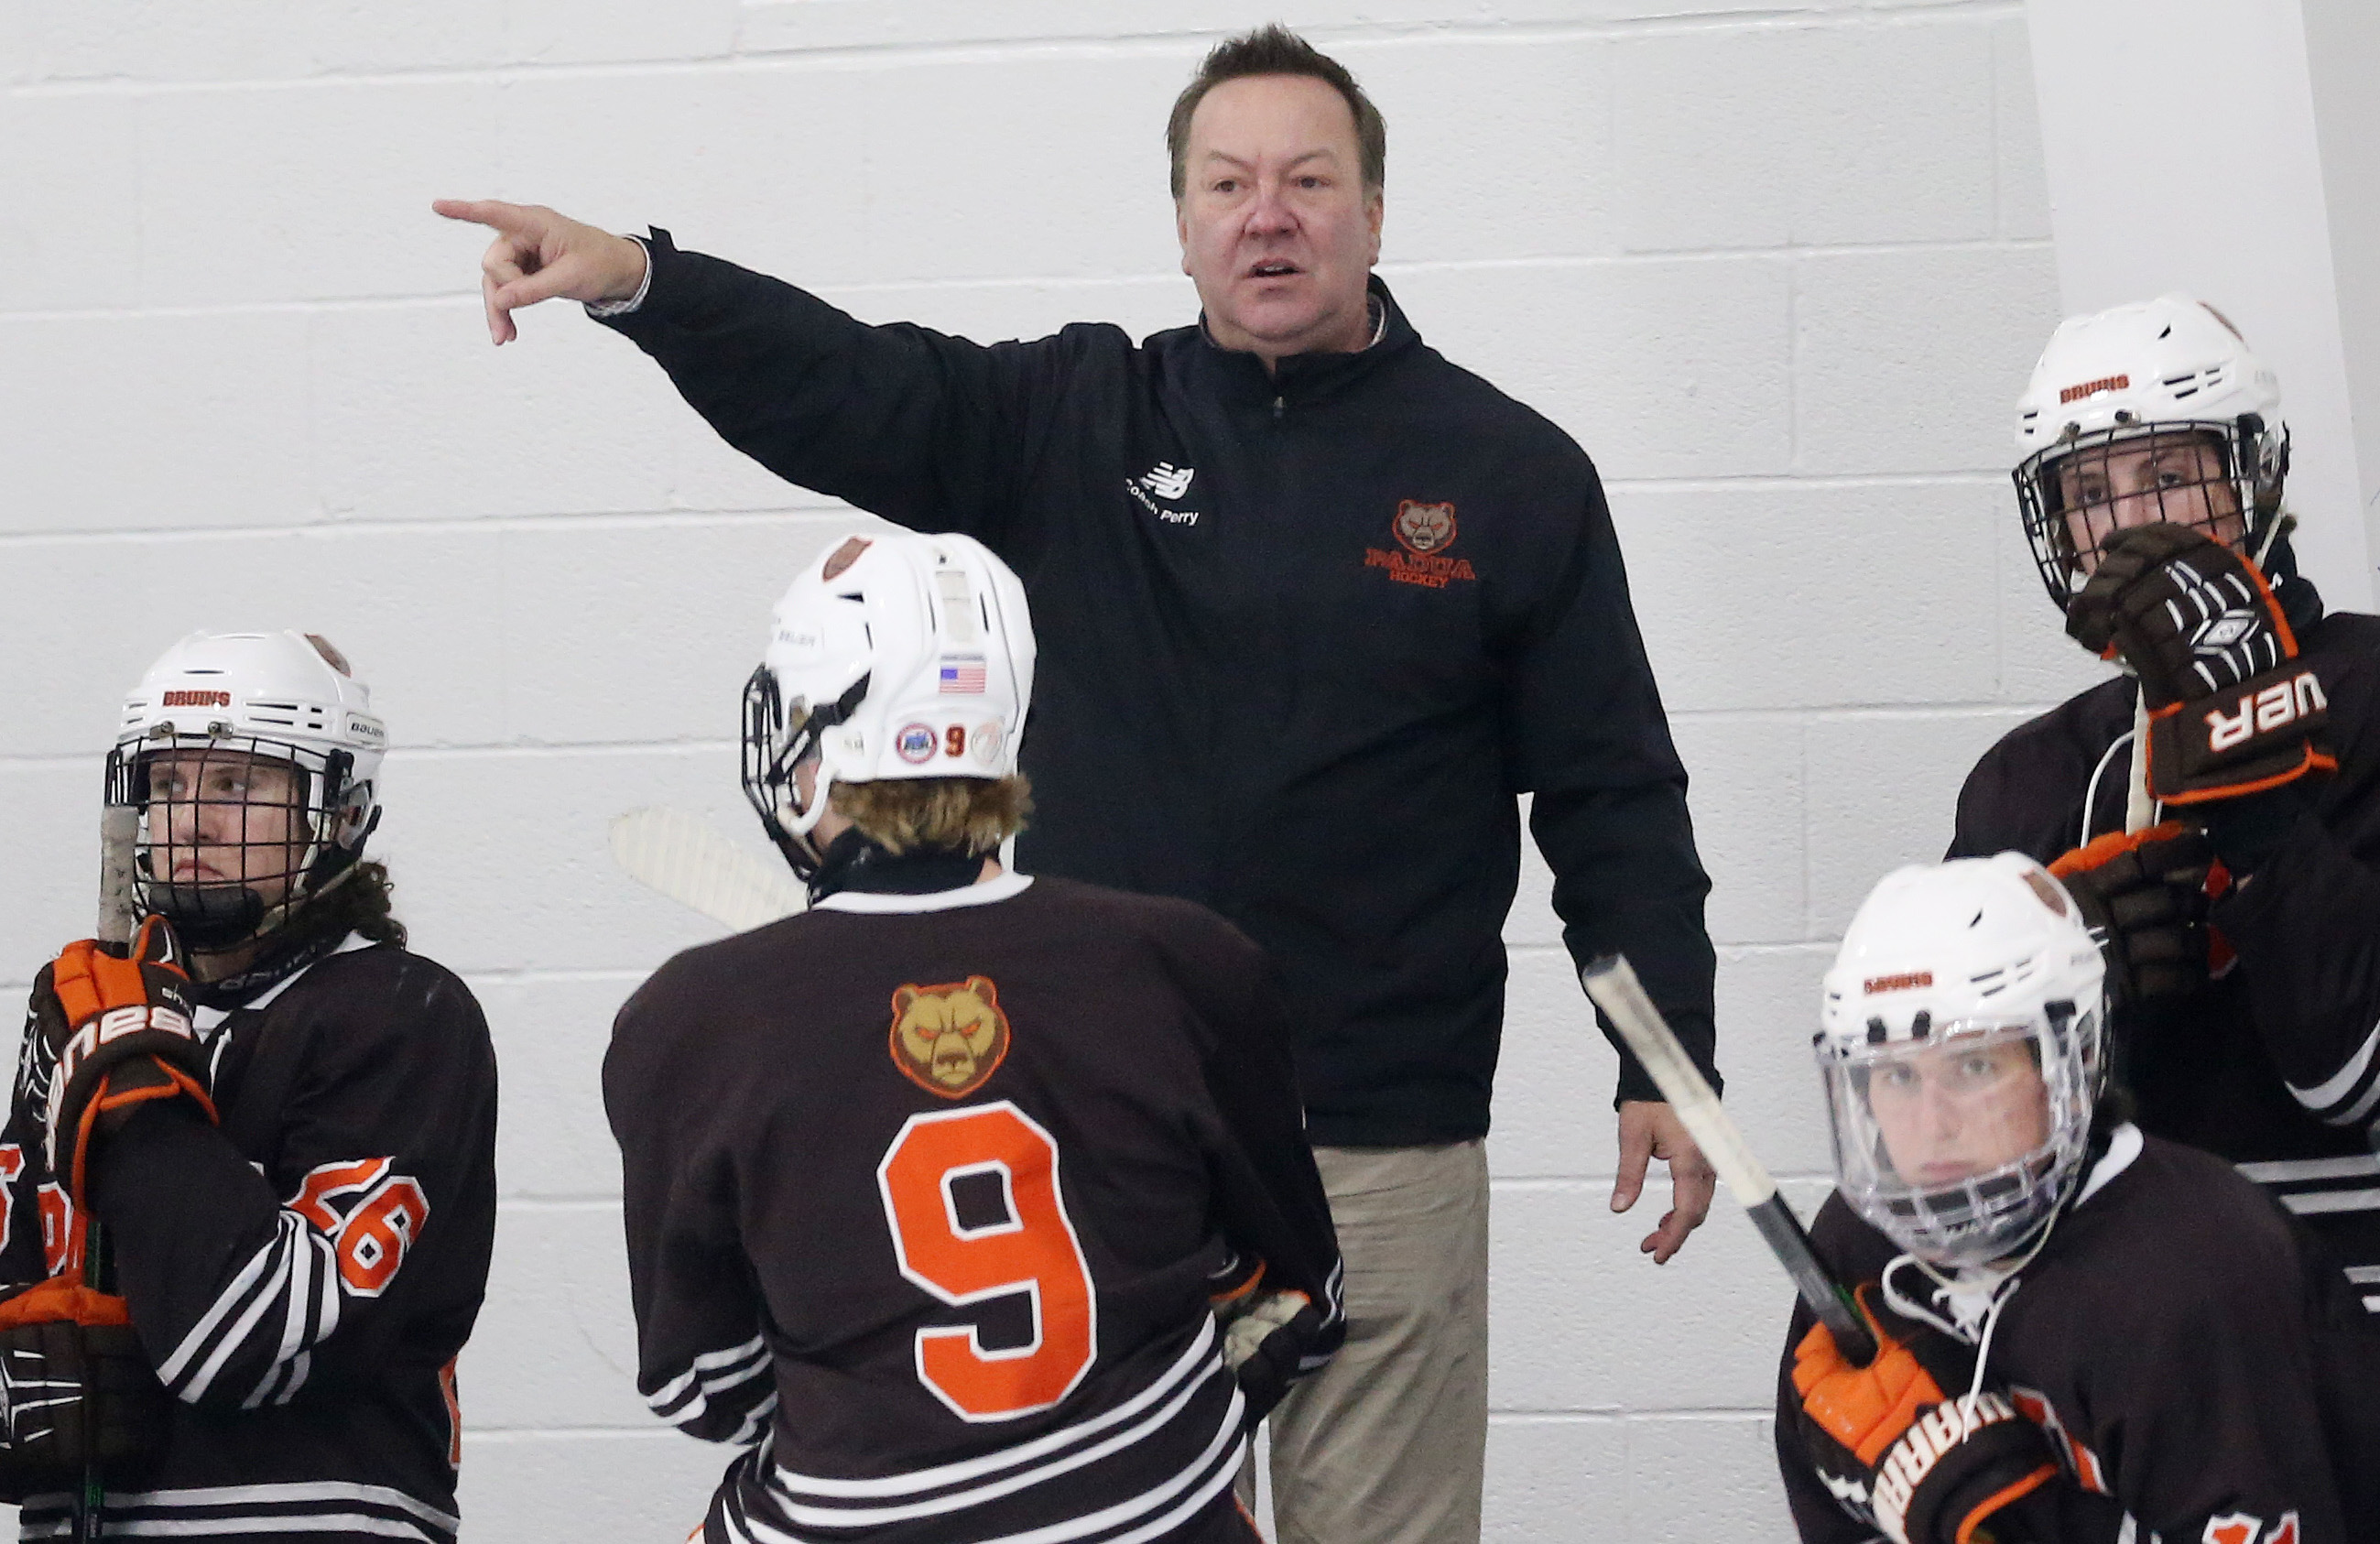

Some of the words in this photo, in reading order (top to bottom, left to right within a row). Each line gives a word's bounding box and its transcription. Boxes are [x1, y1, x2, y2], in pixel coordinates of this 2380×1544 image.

[1159, 509, 1199, 526] Perry
[1389, 570, 1449, 588] HOCKEY
[163, 690, 231, 707] BRUINS
[945, 725, 966, 758] 9
[876, 1100, 1098, 1423] 9
